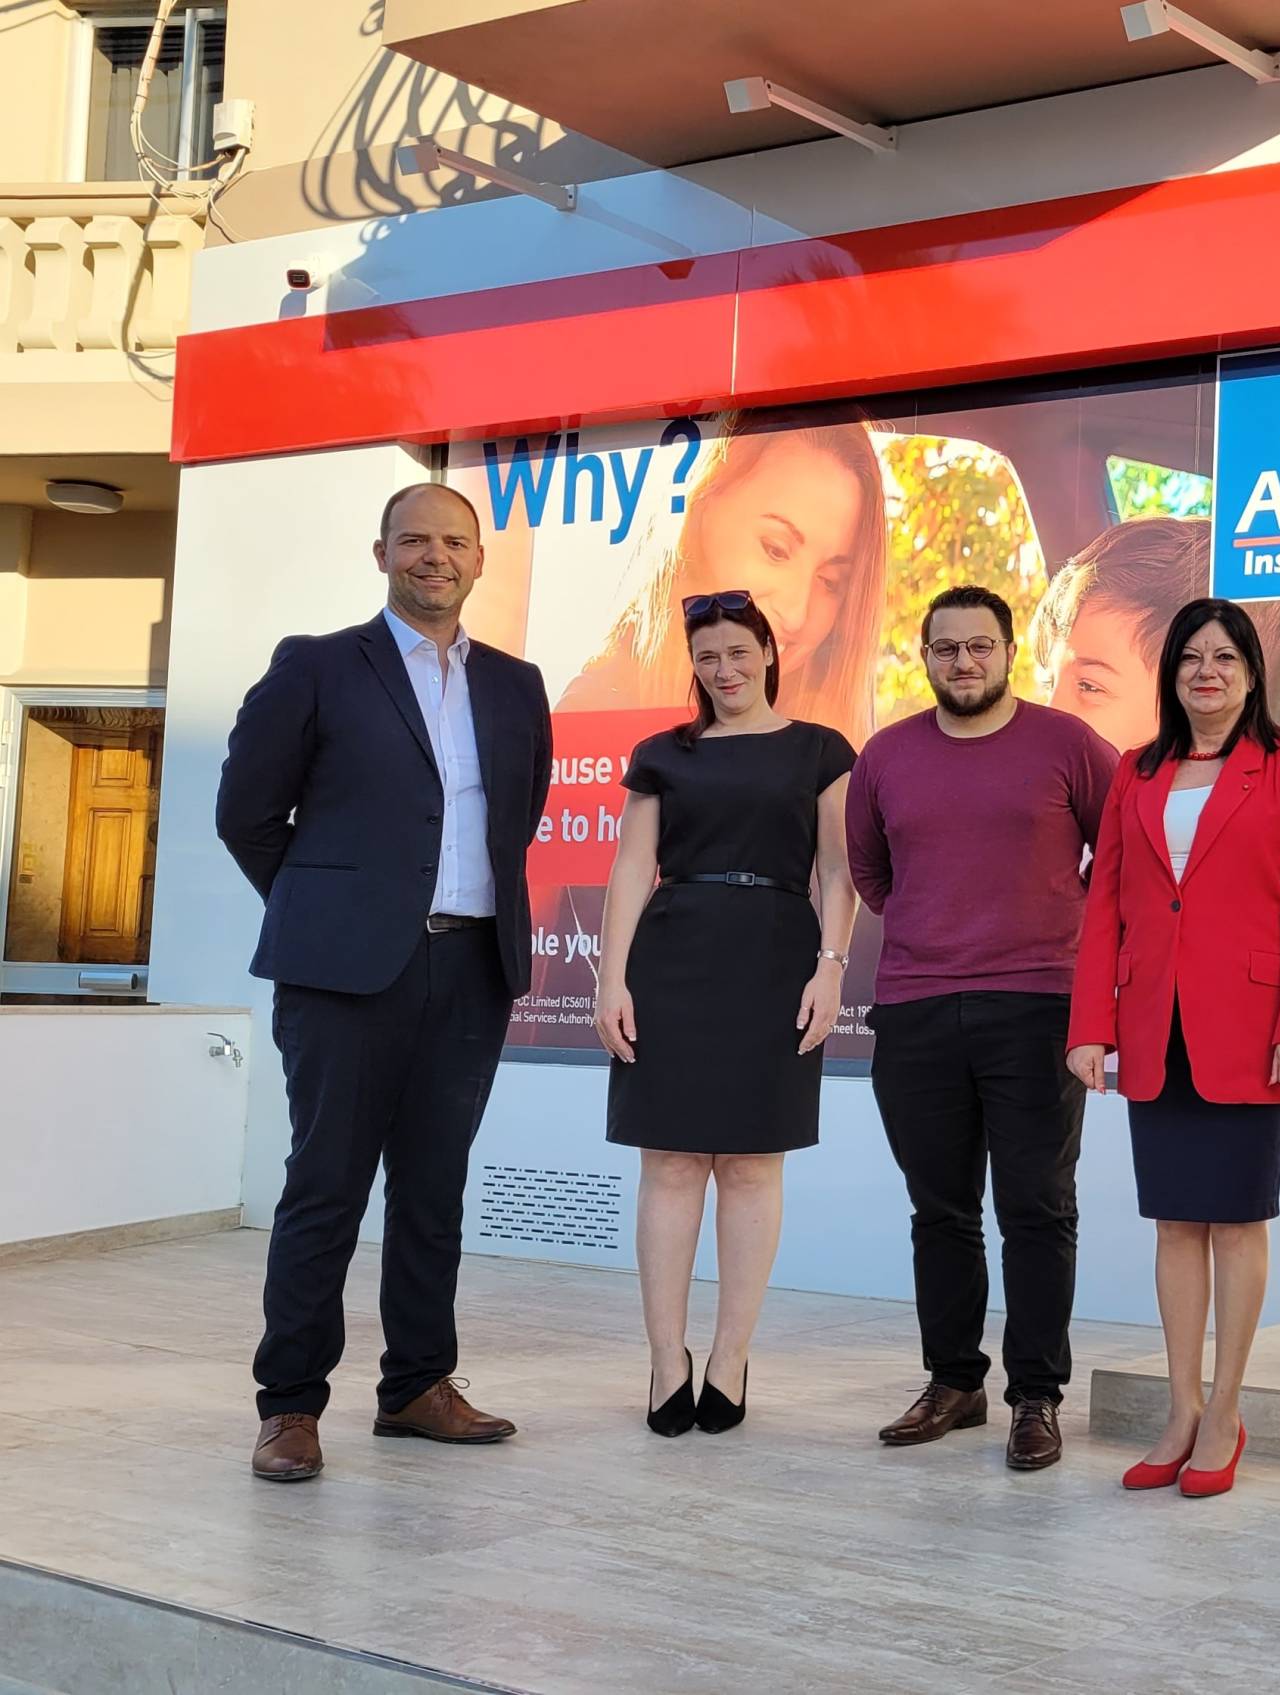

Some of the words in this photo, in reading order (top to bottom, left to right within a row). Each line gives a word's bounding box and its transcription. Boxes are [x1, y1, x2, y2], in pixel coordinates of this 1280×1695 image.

[482, 417, 702, 545] Why?
[561, 808, 589, 842] to
[523, 1010, 557, 1024] Services
[531, 995, 561, 1008] Limited
[561, 995, 591, 1010] (C5601)
[838, 1004, 855, 1018] Act
